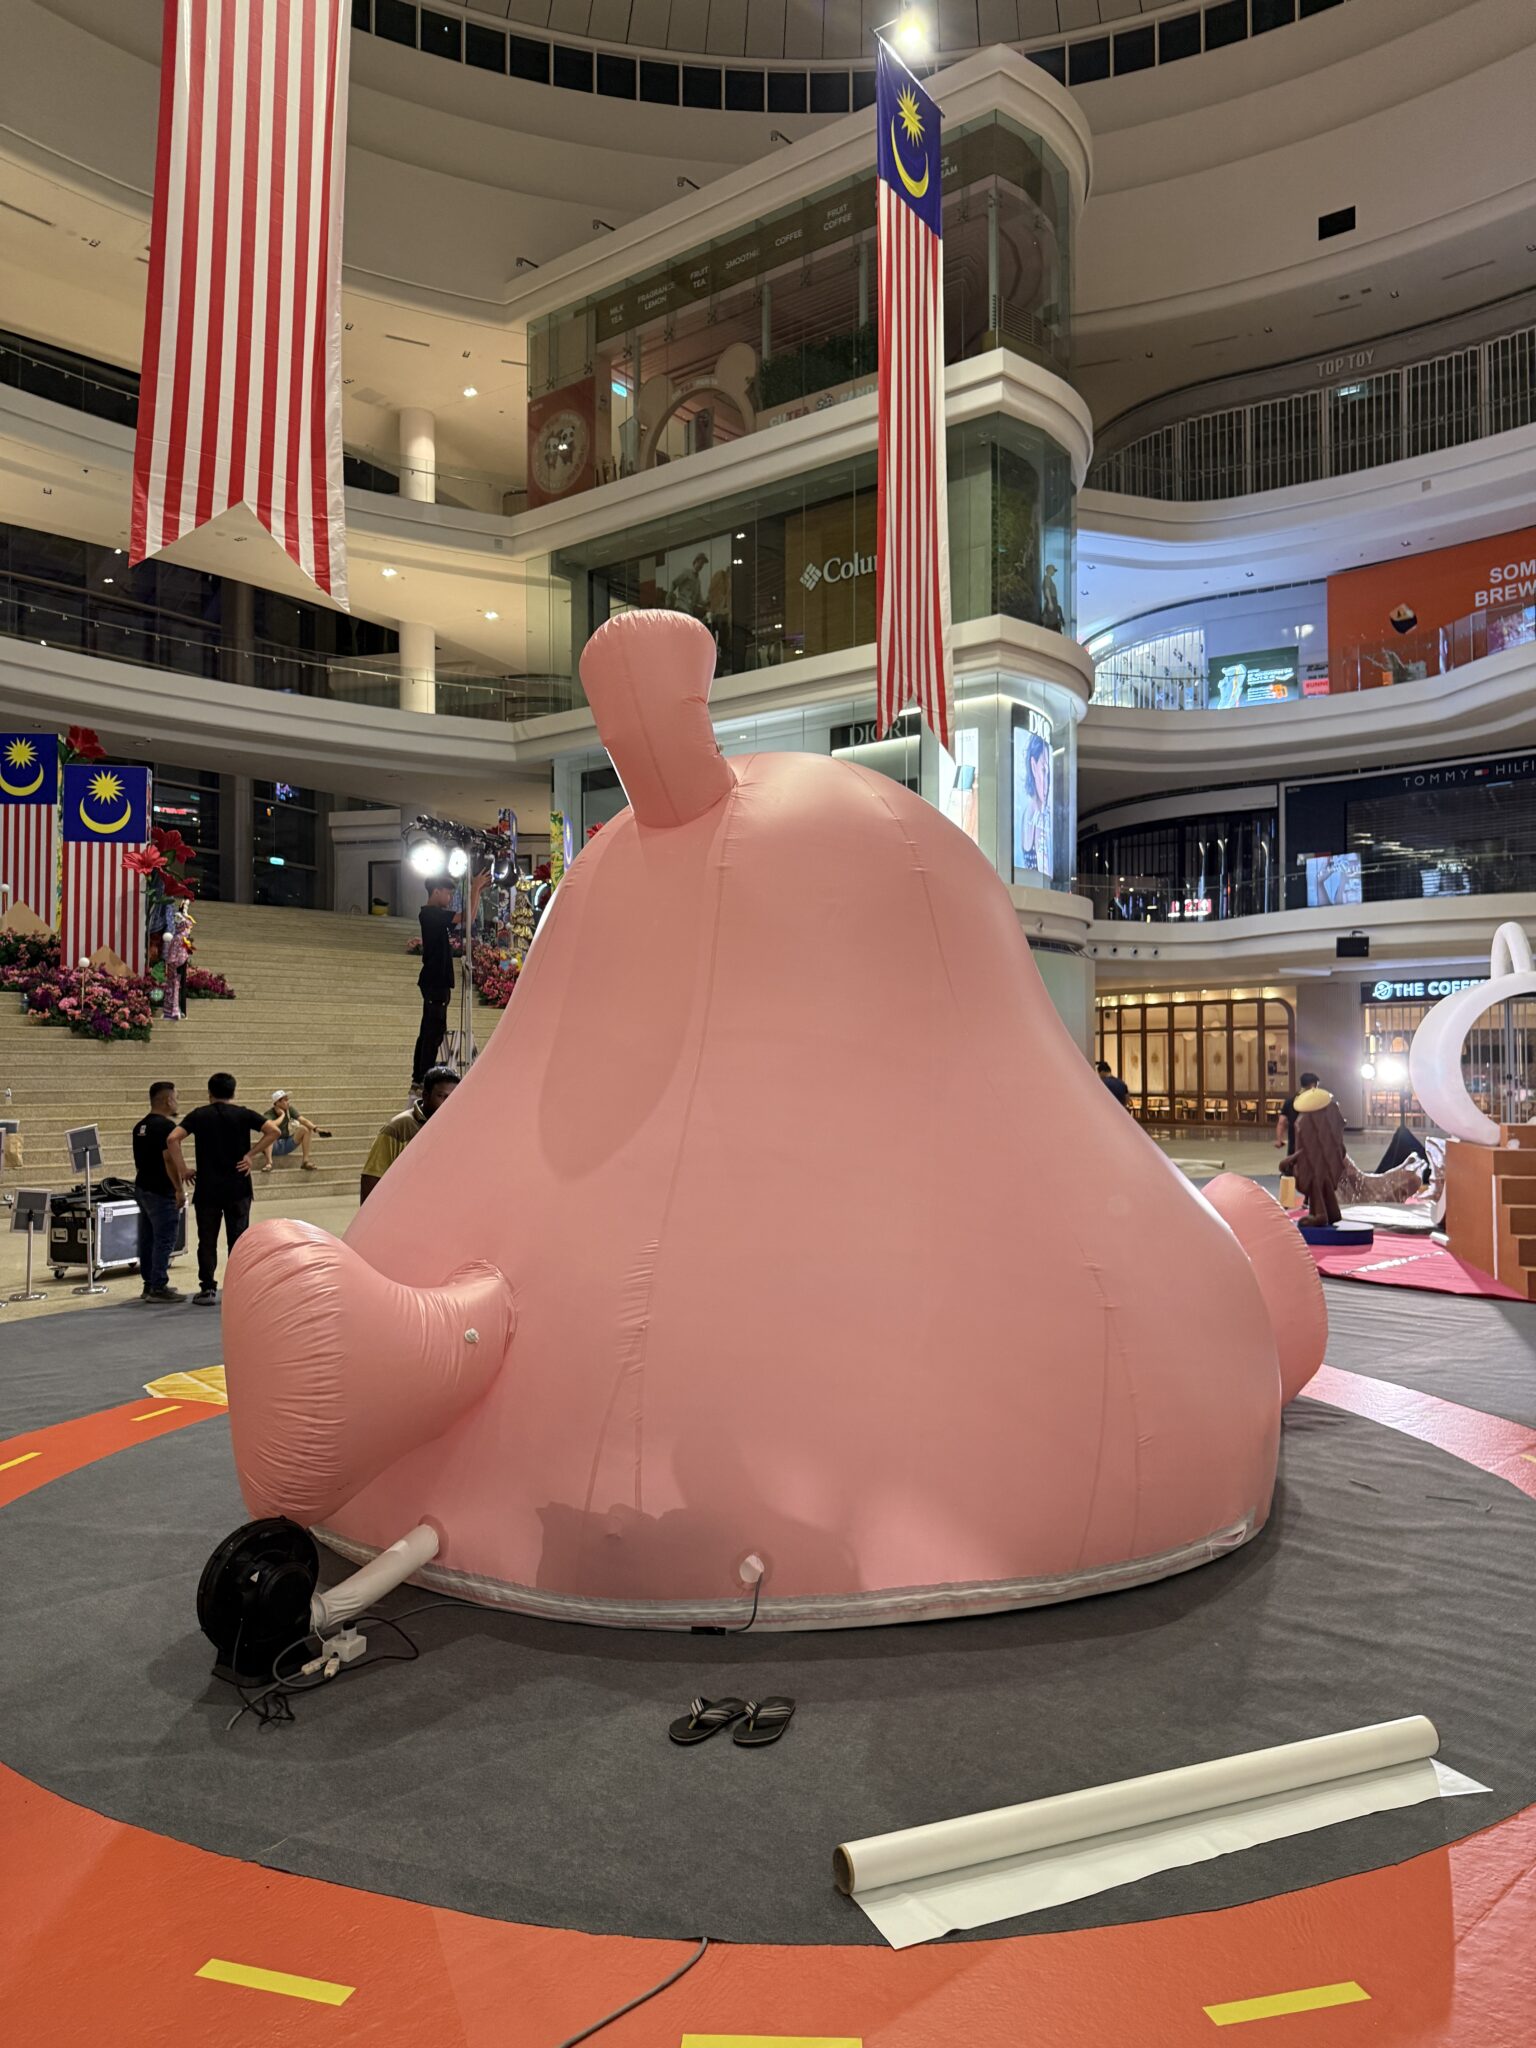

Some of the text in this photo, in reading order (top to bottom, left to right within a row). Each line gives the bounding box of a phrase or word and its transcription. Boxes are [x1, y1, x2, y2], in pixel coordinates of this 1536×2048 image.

[827, 203, 849, 219] FRUIT
[823, 212, 853, 232] COFFEE
[775, 228, 803, 247] COFFEE
[725, 248, 760, 270] SMOOTHIE
[690, 264, 711, 281] FRUIT
[693, 278, 706, 289] TEA
[609, 304, 625, 316] MILK
[644, 294, 668, 311] LEMON
[611, 316, 623, 325] TEA
[1316, 349, 1375, 378] TOP TOY
[840, 382, 878, 402] PAND
[822, 551, 878, 584] Colu
[1489, 558, 1536, 585] SOM
[1474, 579, 1536, 608] BREW
[1028, 710, 1051, 745] DIOR
[1403, 759, 1536, 788] TOMMY HILFI
[1393, 980, 1425, 997] THE
